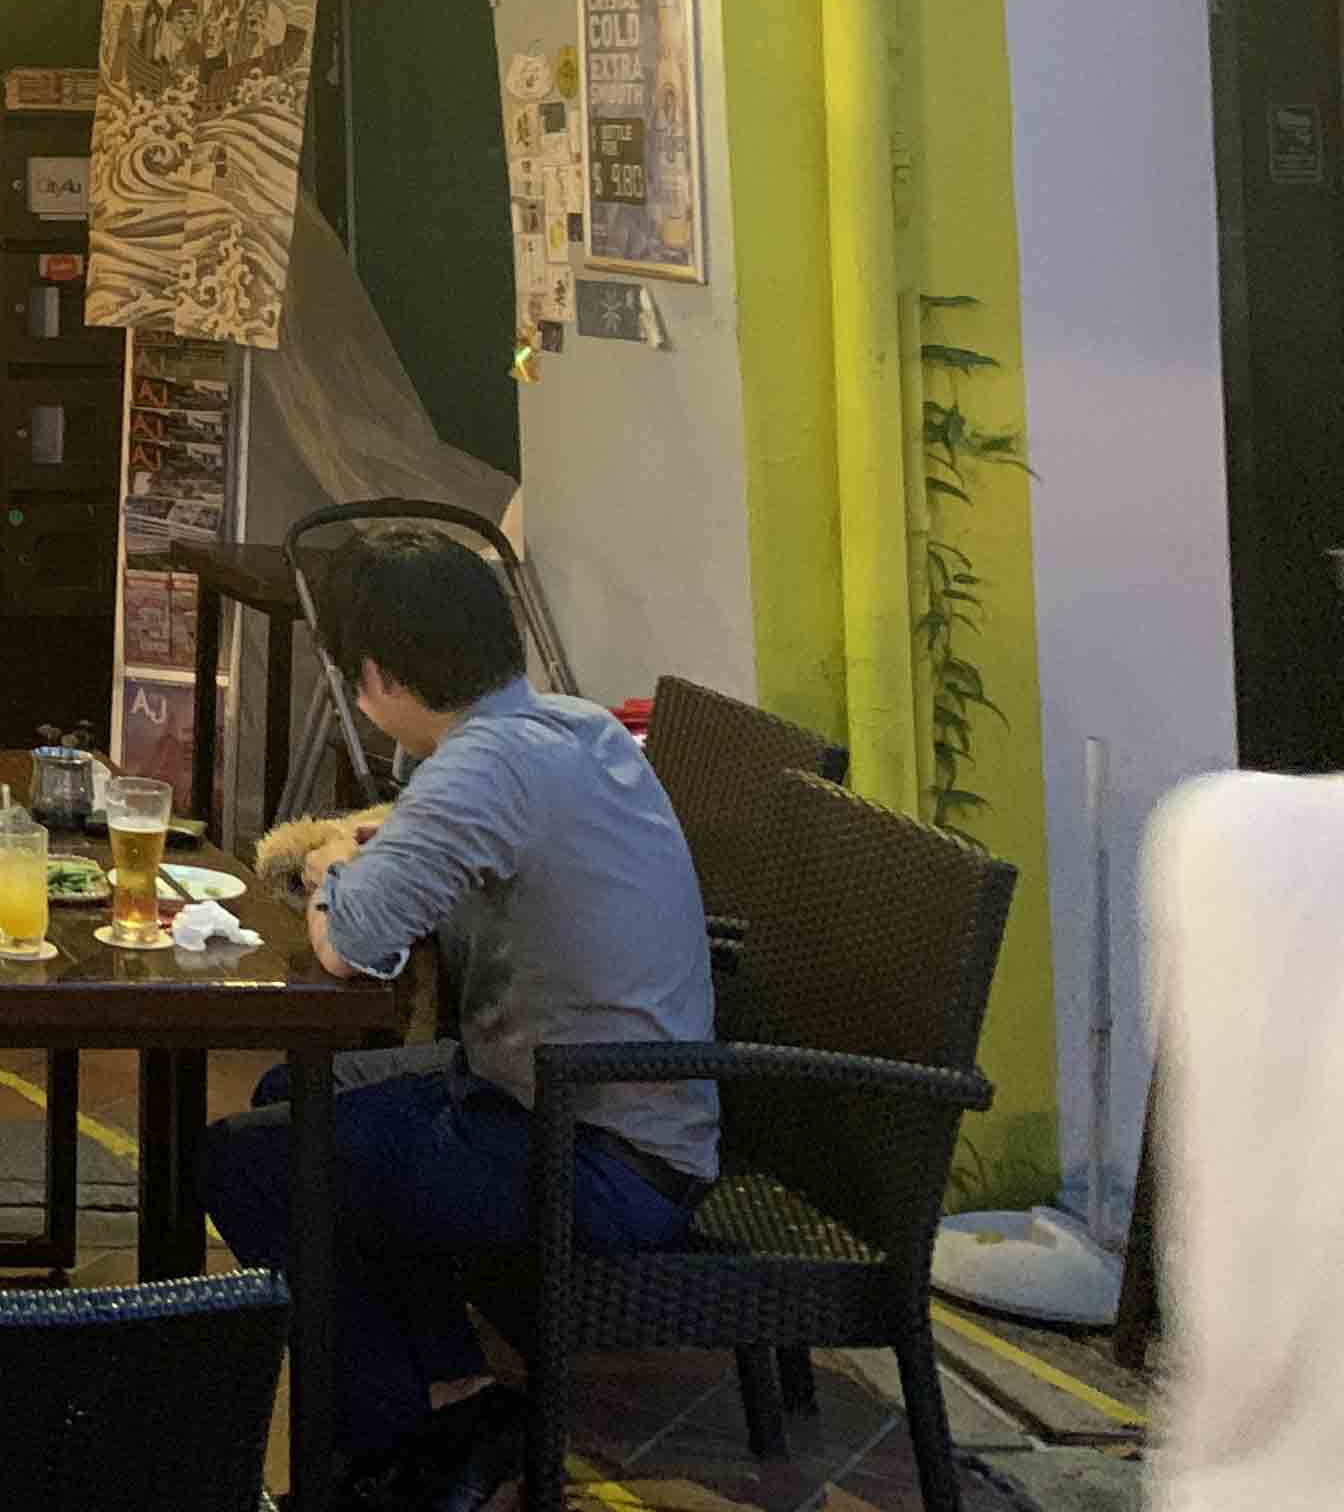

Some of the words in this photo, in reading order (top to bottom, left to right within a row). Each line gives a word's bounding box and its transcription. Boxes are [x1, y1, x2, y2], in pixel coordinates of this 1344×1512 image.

[588, 12, 640, 49] COLD
[137, 381, 169, 409] AJ
[130, 685, 169, 724] AJ
